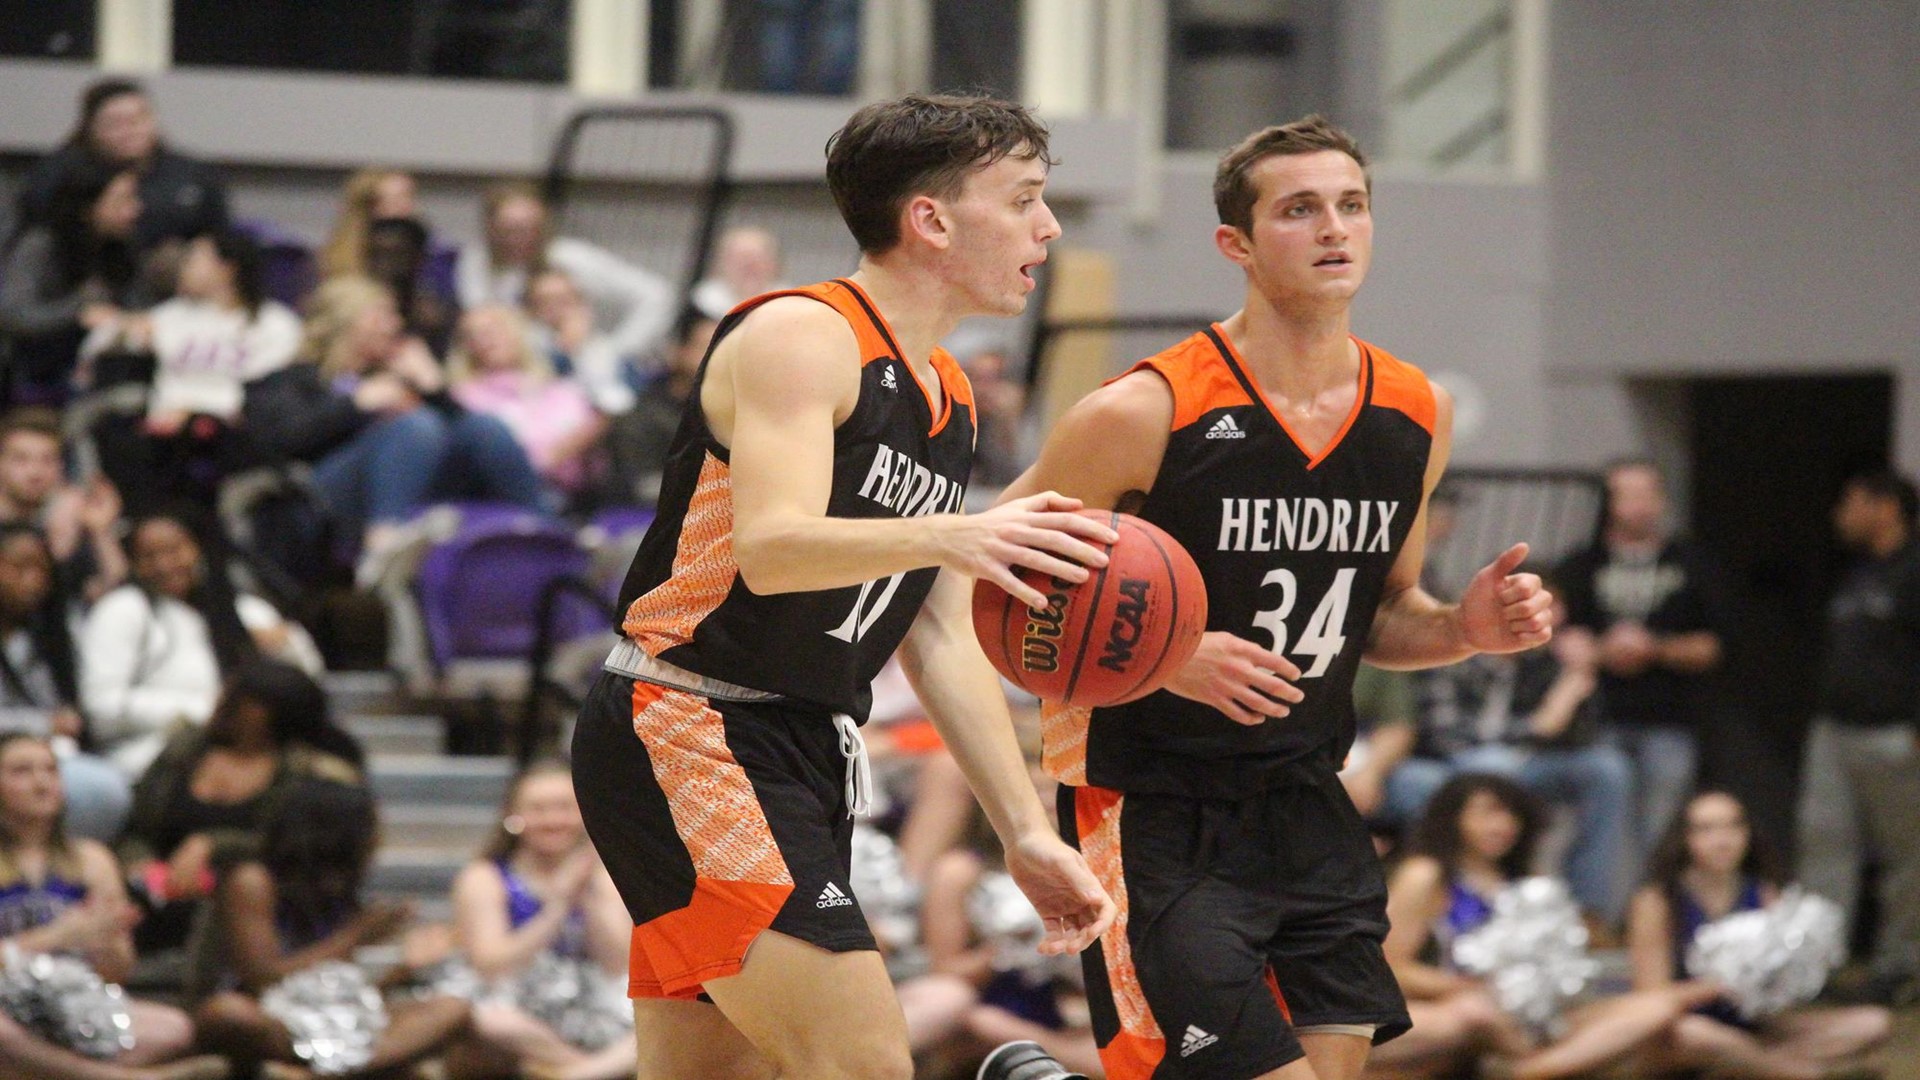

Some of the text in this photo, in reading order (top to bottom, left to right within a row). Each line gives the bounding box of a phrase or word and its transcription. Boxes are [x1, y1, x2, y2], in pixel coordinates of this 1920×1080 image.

[1205, 430, 1246, 440] adidas
[1217, 497, 1399, 553] HENDRIX
[1097, 578, 1150, 673] NCAA
[1251, 567, 1358, 678] 34
[816, 897, 853, 909] adidas
[1180, 1033, 1219, 1058] adidas
